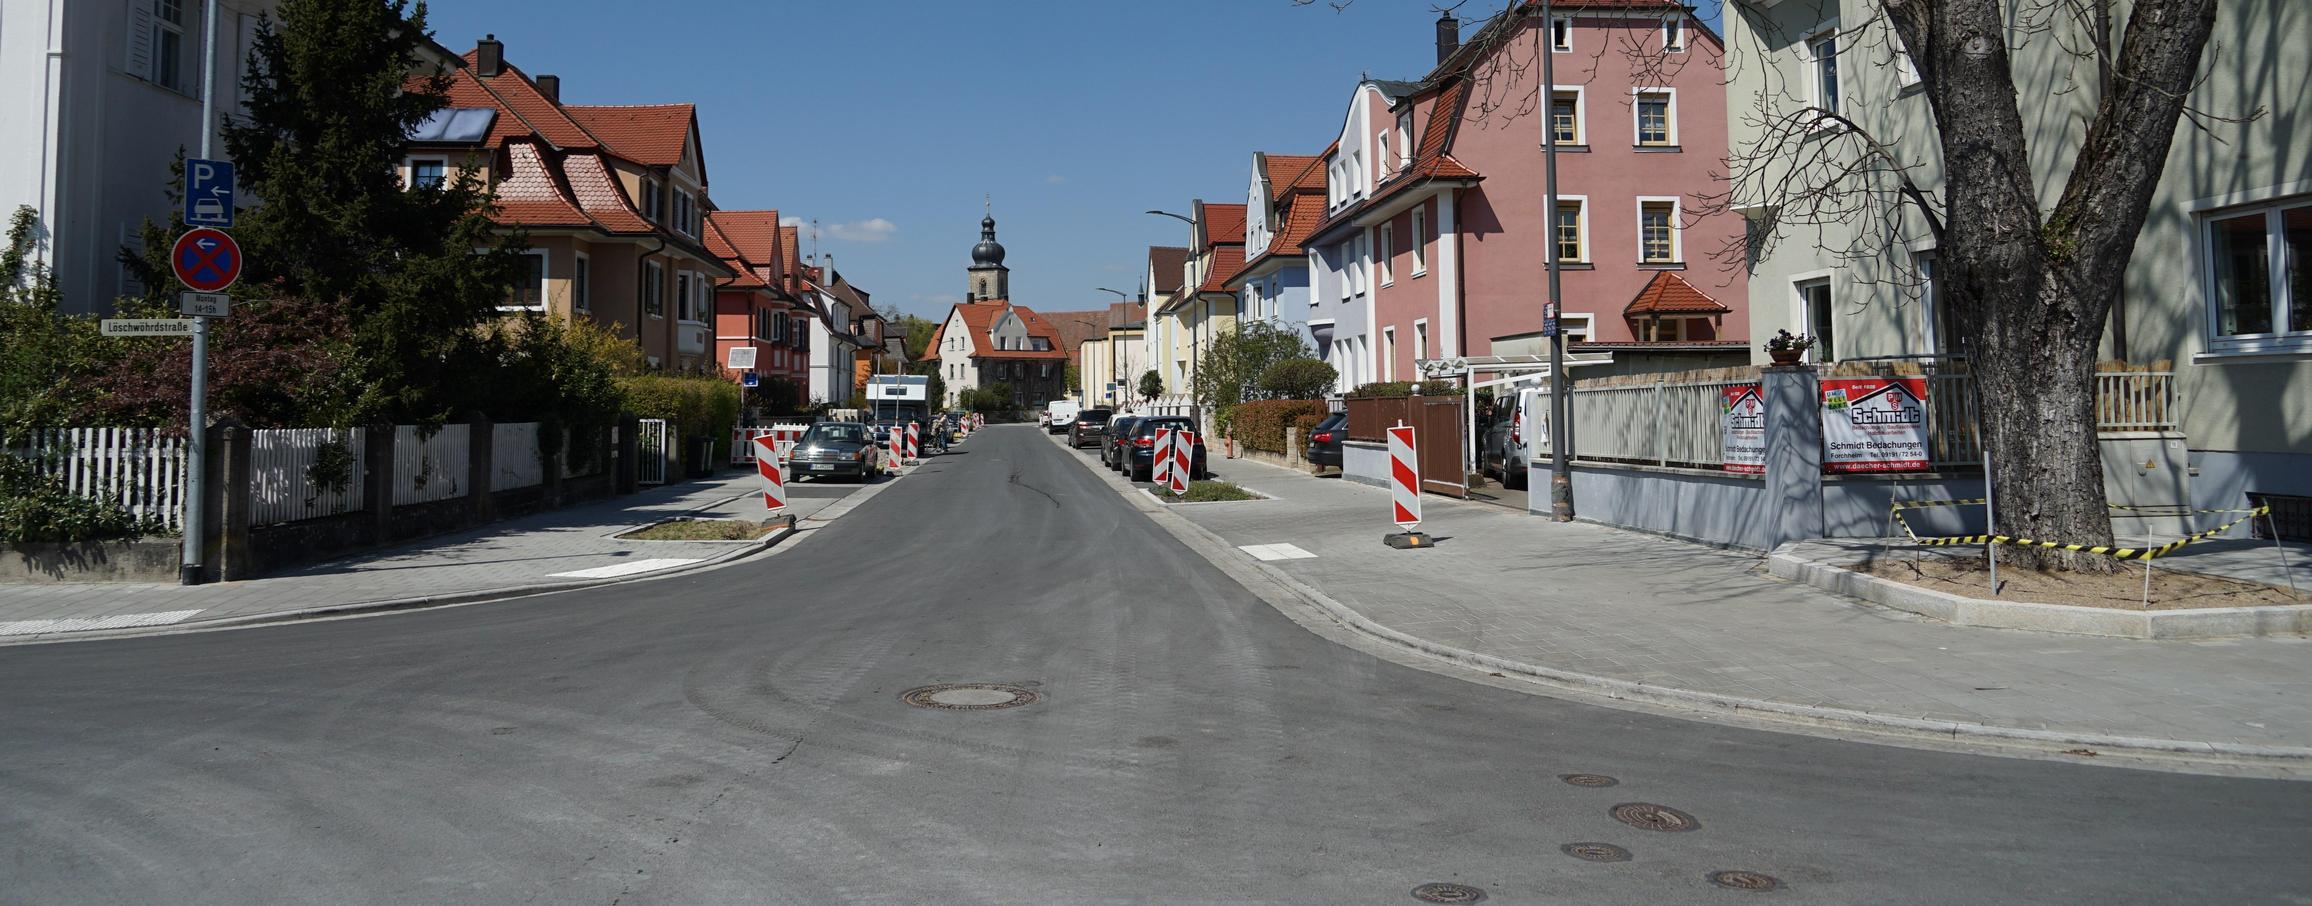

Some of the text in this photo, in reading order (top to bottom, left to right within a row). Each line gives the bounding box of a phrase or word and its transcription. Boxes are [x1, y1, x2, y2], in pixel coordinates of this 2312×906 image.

[194, 163, 214, 189] P
[196, 294, 217, 304] Montag
[195, 304, 217, 313] 14-15h
[108, 321, 188, 332] Löschwöhrdstraße
[1852, 406, 1921, 424] Schmidt
[1830, 440, 1922, 450] Schmidt Bedachungen
[1833, 461, 1921, 470] www.daecher-schmidt.de
